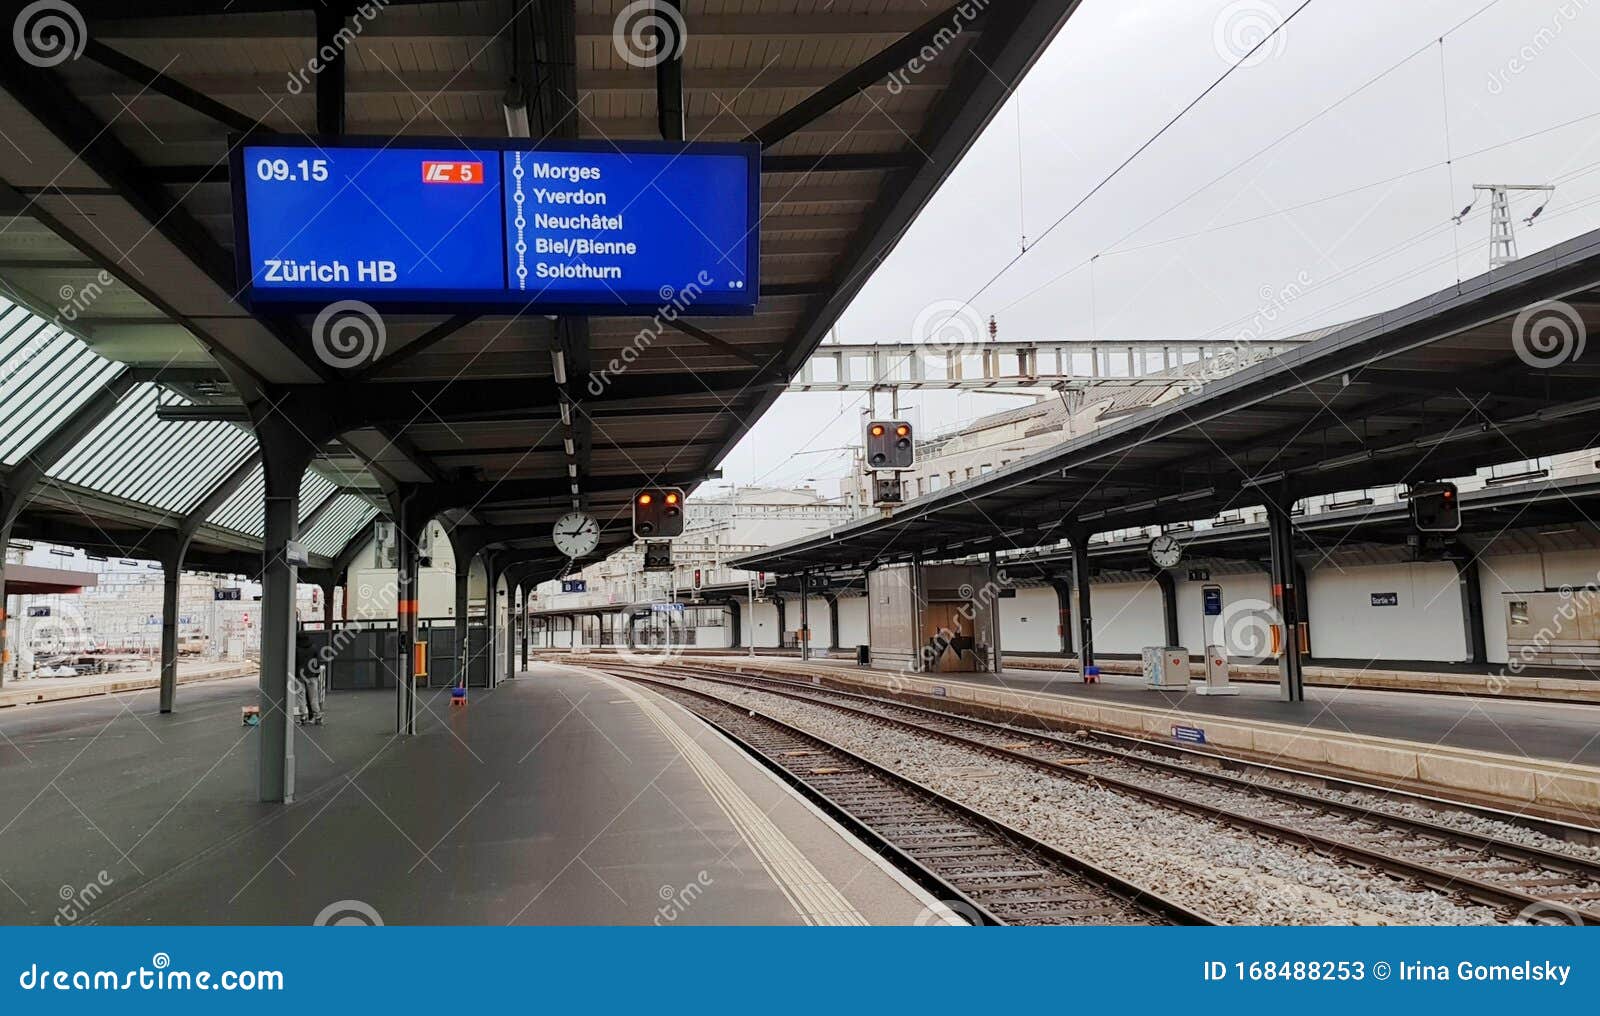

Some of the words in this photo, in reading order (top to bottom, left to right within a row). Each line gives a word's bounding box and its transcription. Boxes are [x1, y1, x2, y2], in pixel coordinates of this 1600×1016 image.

[256, 159, 329, 182] 09.15
[426, 164, 454, 181] IC
[460, 164, 473, 182] 5
[533, 162, 601, 183] Morges
[533, 188, 607, 205] Yverdon
[534, 212, 623, 231] Neuchâtel
[535, 238, 637, 256] Biel/Bienne
[264, 259, 350, 283] Zürich
[357, 260, 397, 282] HB
[536, 262, 622, 280] Solothurn
